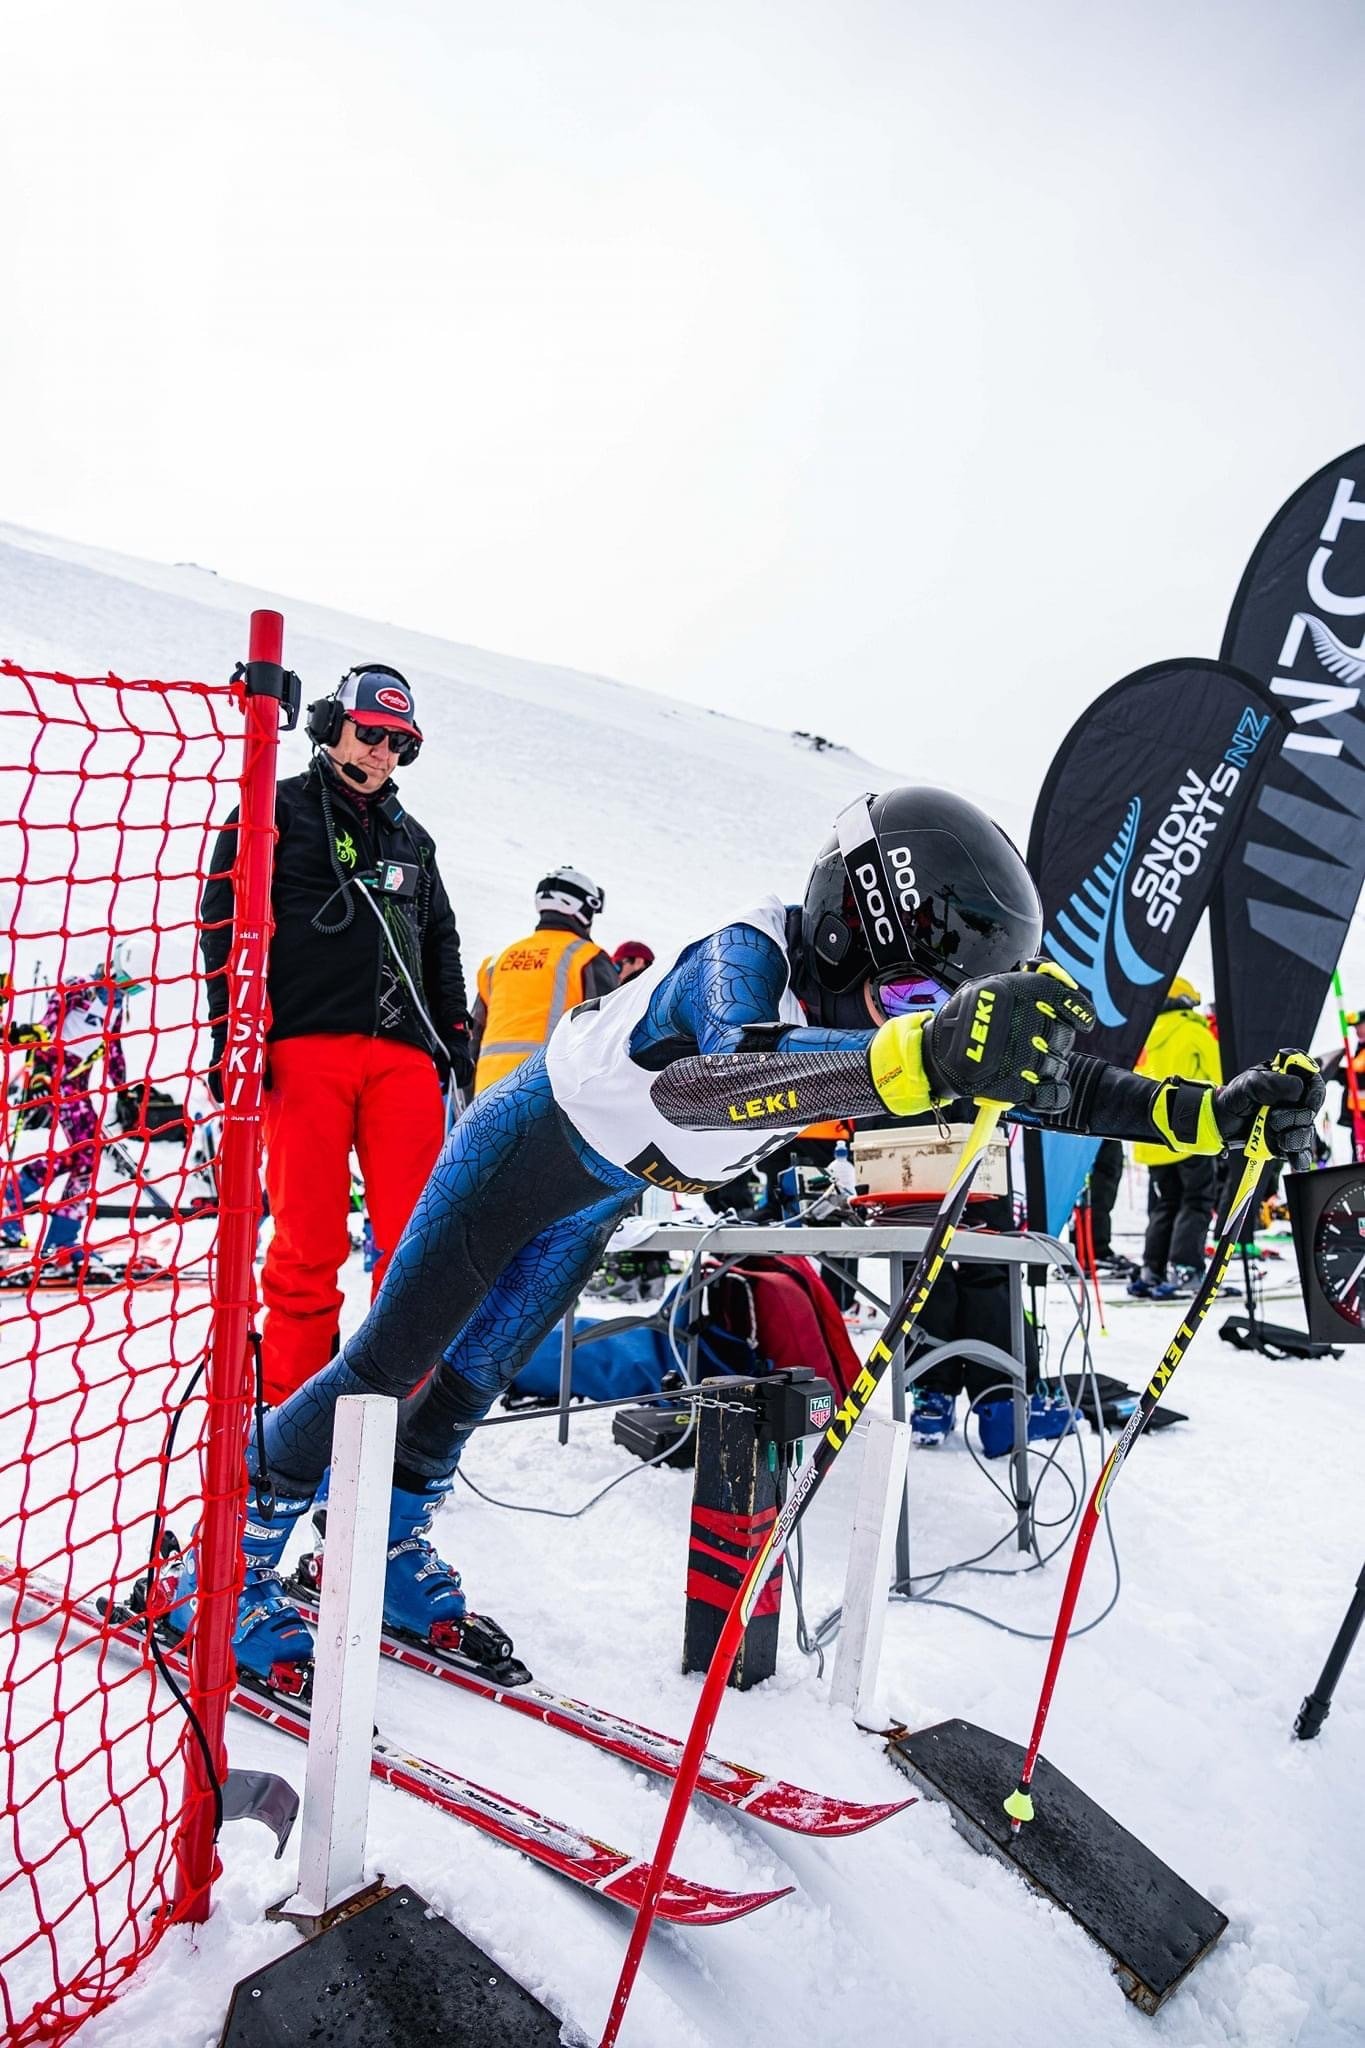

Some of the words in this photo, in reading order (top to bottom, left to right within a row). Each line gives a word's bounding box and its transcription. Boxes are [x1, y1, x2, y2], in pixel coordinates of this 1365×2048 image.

[1131, 768, 1206, 903] SNOW
[500, 959, 545, 971] CREW
[966, 989, 996, 1063] LEKI
[1063, 998, 1093, 1024] LEKI
[728, 1090, 798, 1121] LEKI
[1250, 1114, 1265, 1152] LEKI
[1147, 1322, 1194, 1399] LEKI
[812, 1398, 829, 1410] TAG
[826, 1338, 893, 1451] LEKI
